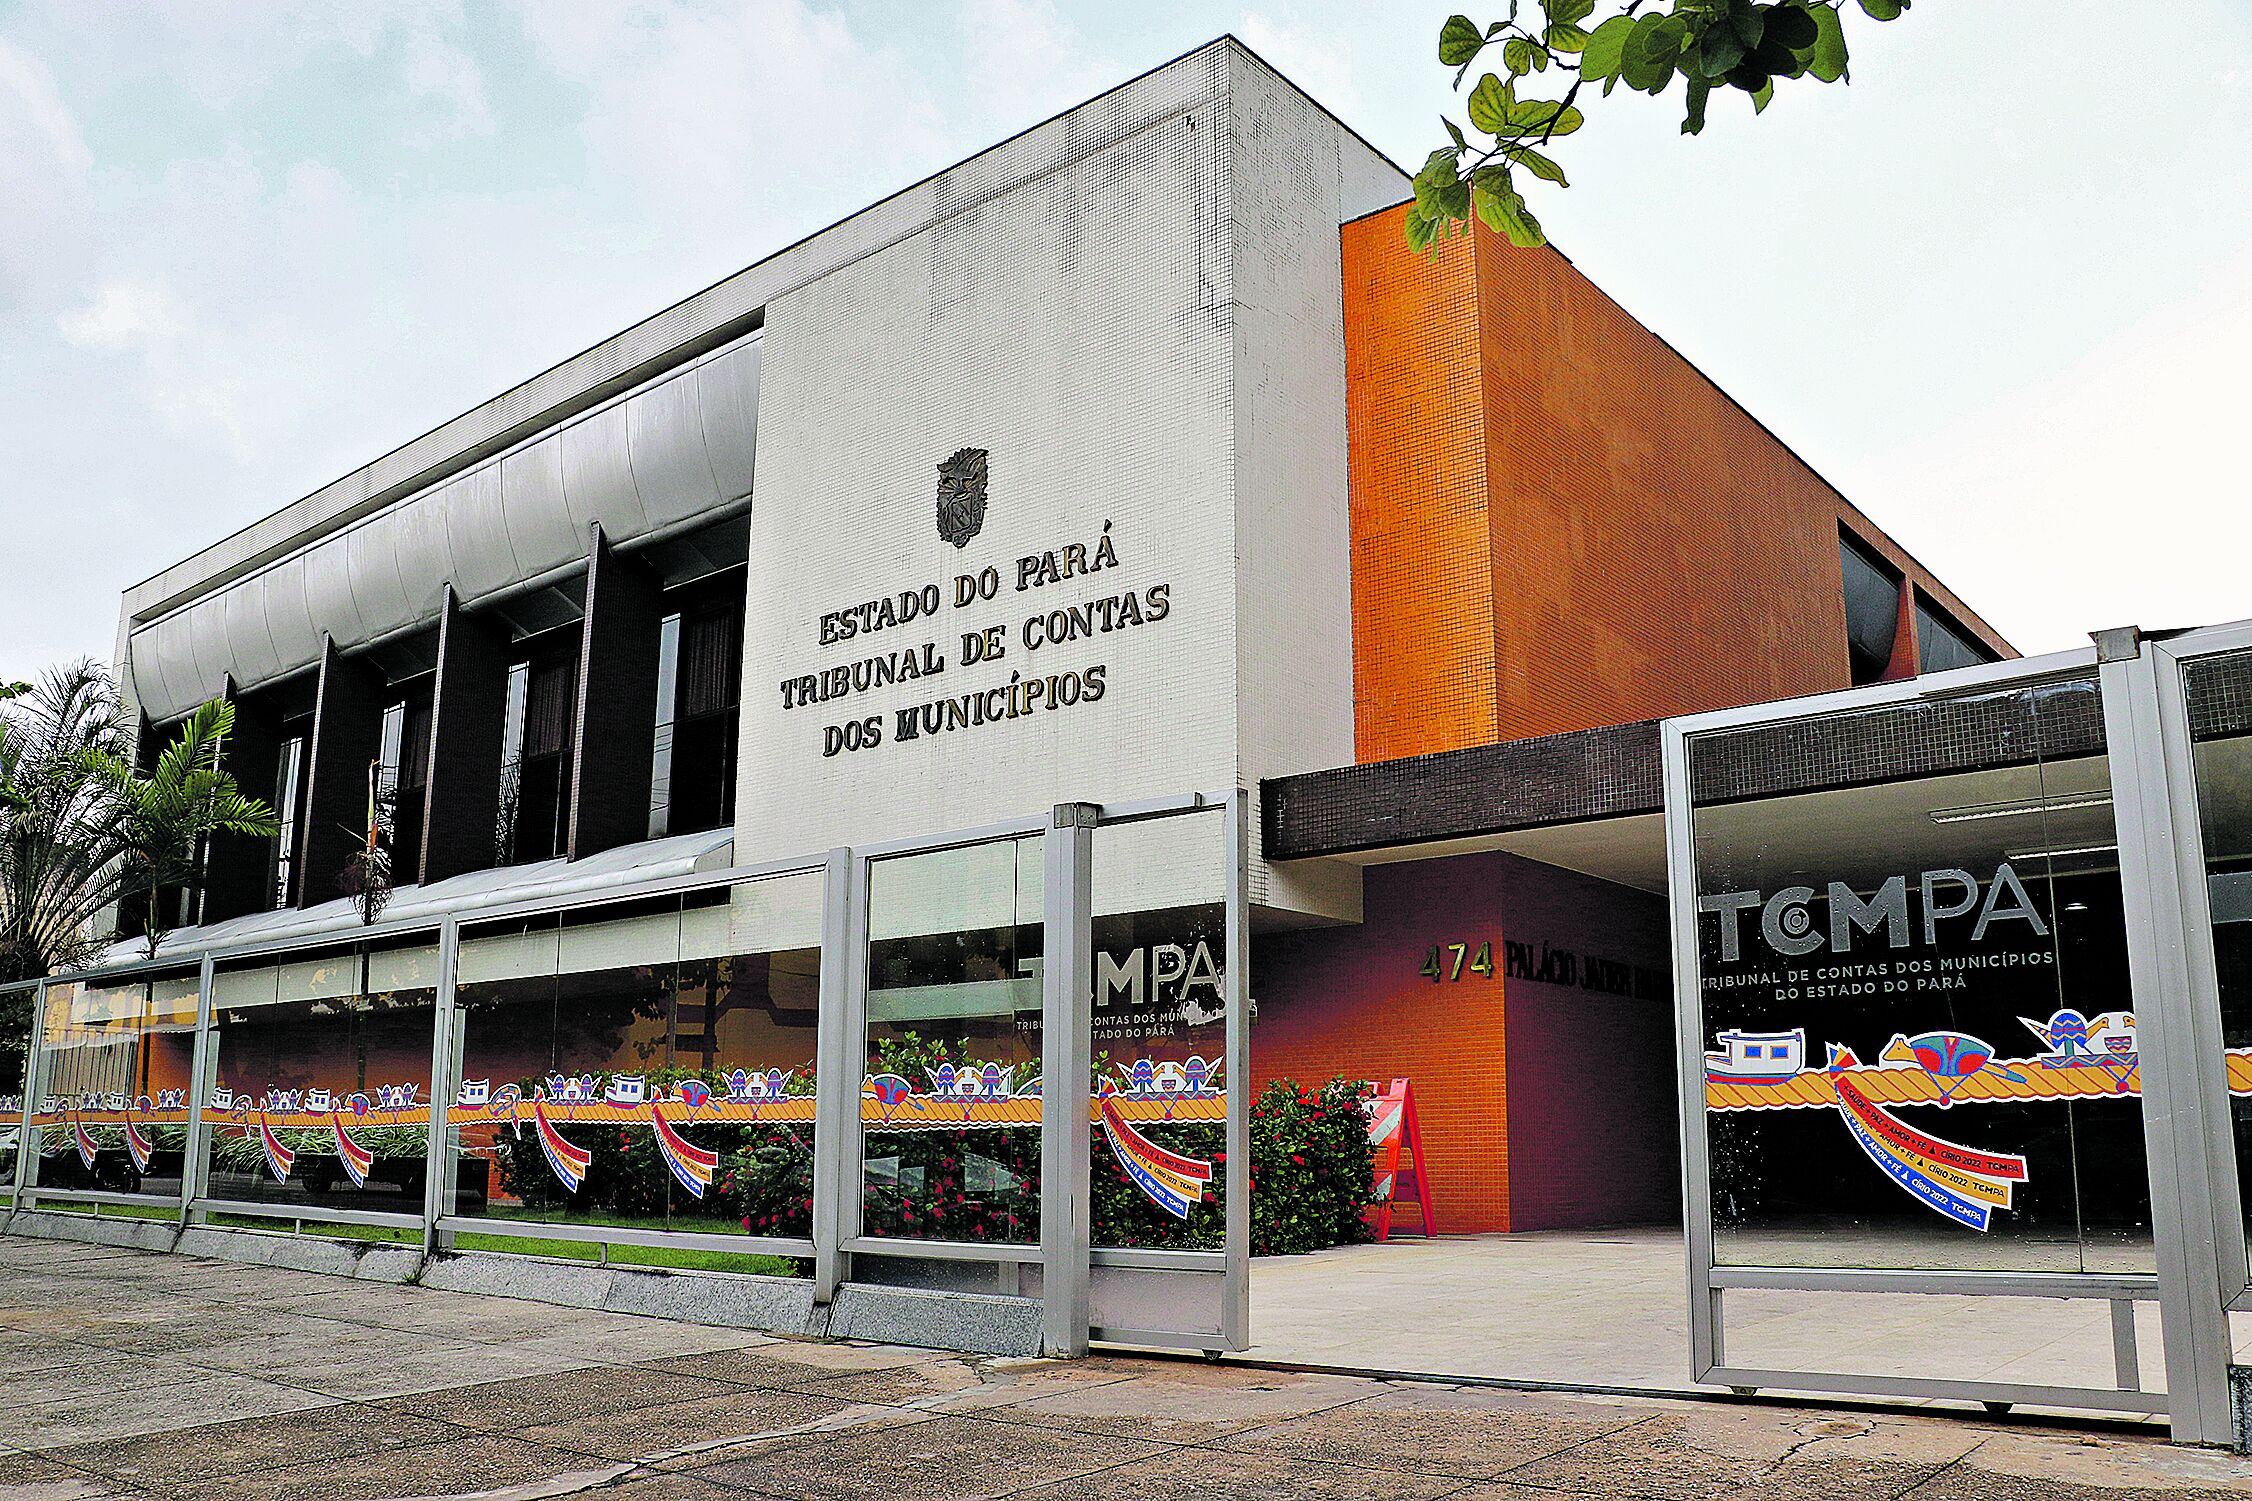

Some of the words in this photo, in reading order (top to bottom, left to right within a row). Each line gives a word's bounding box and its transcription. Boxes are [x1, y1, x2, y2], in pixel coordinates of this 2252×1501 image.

[819, 584, 939, 646] ESTADO
[953, 566, 999, 608] DO
[1016, 519, 1118, 592] PARÁ
[780, 643, 944, 710] TRIBUNAL
[960, 625, 1007, 666] DE
[1023, 584, 1170, 651] CONTAS
[823, 715, 881, 758] DOS
[895, 665, 1107, 743] MUNICÍPIOS
[1698, 862, 2050, 962] TCMPA
[1419, 941, 1492, 982] 474
[1788, 969, 1809, 983] DE
[1817, 963, 1888, 980] CONTAS
[1896, 960, 1932, 974] DOS
[1941, 951, 2053, 971] MUNICÍPIOS
[1775, 987, 1799, 1001] DO
[1807, 982, 1876, 998] ESTADO
[1884, 980, 1909, 993] DO
[1917, 973, 1967, 991] PARÁ
[1125, 1026, 1141, 1038] DO
[1133, 1013, 1156, 1024] DOS
[1889, 1126, 1911, 1142] AMOR
[1962, 1158, 1982, 1168] 2022
[1986, 1161, 2019, 1173] TCMPA
[1868, 1142, 1888, 1161] AMOR
[1930, 1190, 1949, 1205] 2022
[1951, 1201, 1981, 1221] TCMPA
[1949, 1174, 1968, 1187] 2022
[1972, 1182, 2005, 1198] TCMPA
